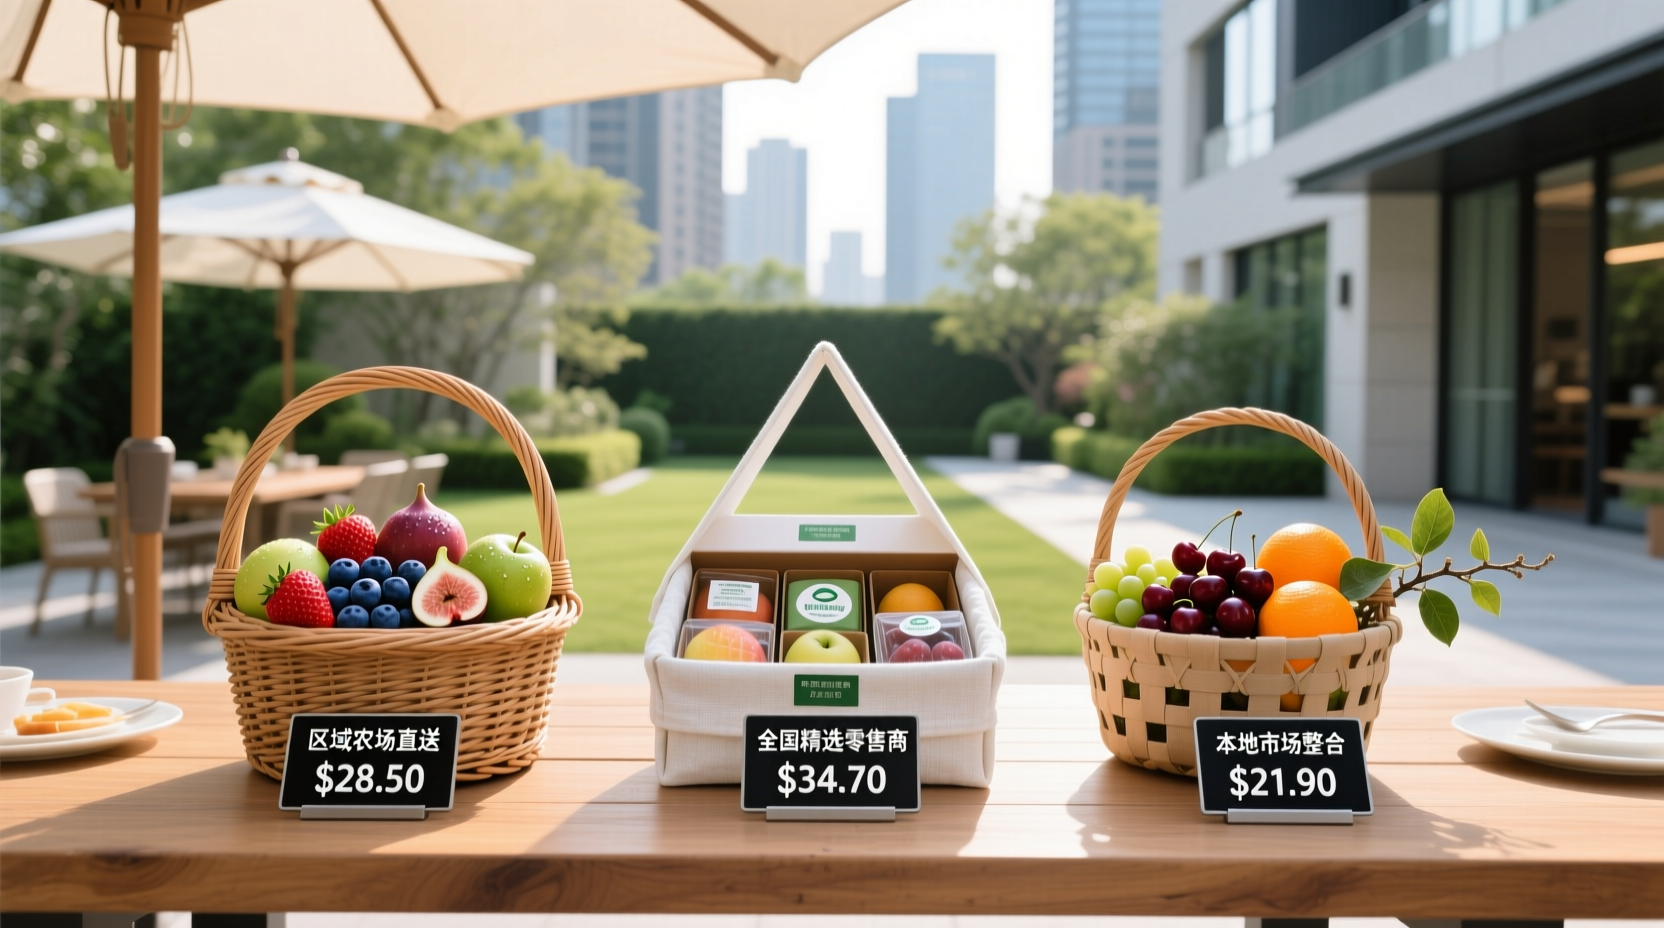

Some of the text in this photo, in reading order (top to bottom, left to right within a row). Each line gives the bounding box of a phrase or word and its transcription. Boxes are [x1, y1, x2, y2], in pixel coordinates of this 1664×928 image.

[308, 727, 440, 752] 区域农场直送
[758, 728, 909, 752] 全国精选零售商
[1216, 731, 1345, 755] 本地市场整合
[314, 760, 425, 798] $28.50
[777, 761, 887, 798] $34.70
[1229, 764, 1337, 801] $21.90
